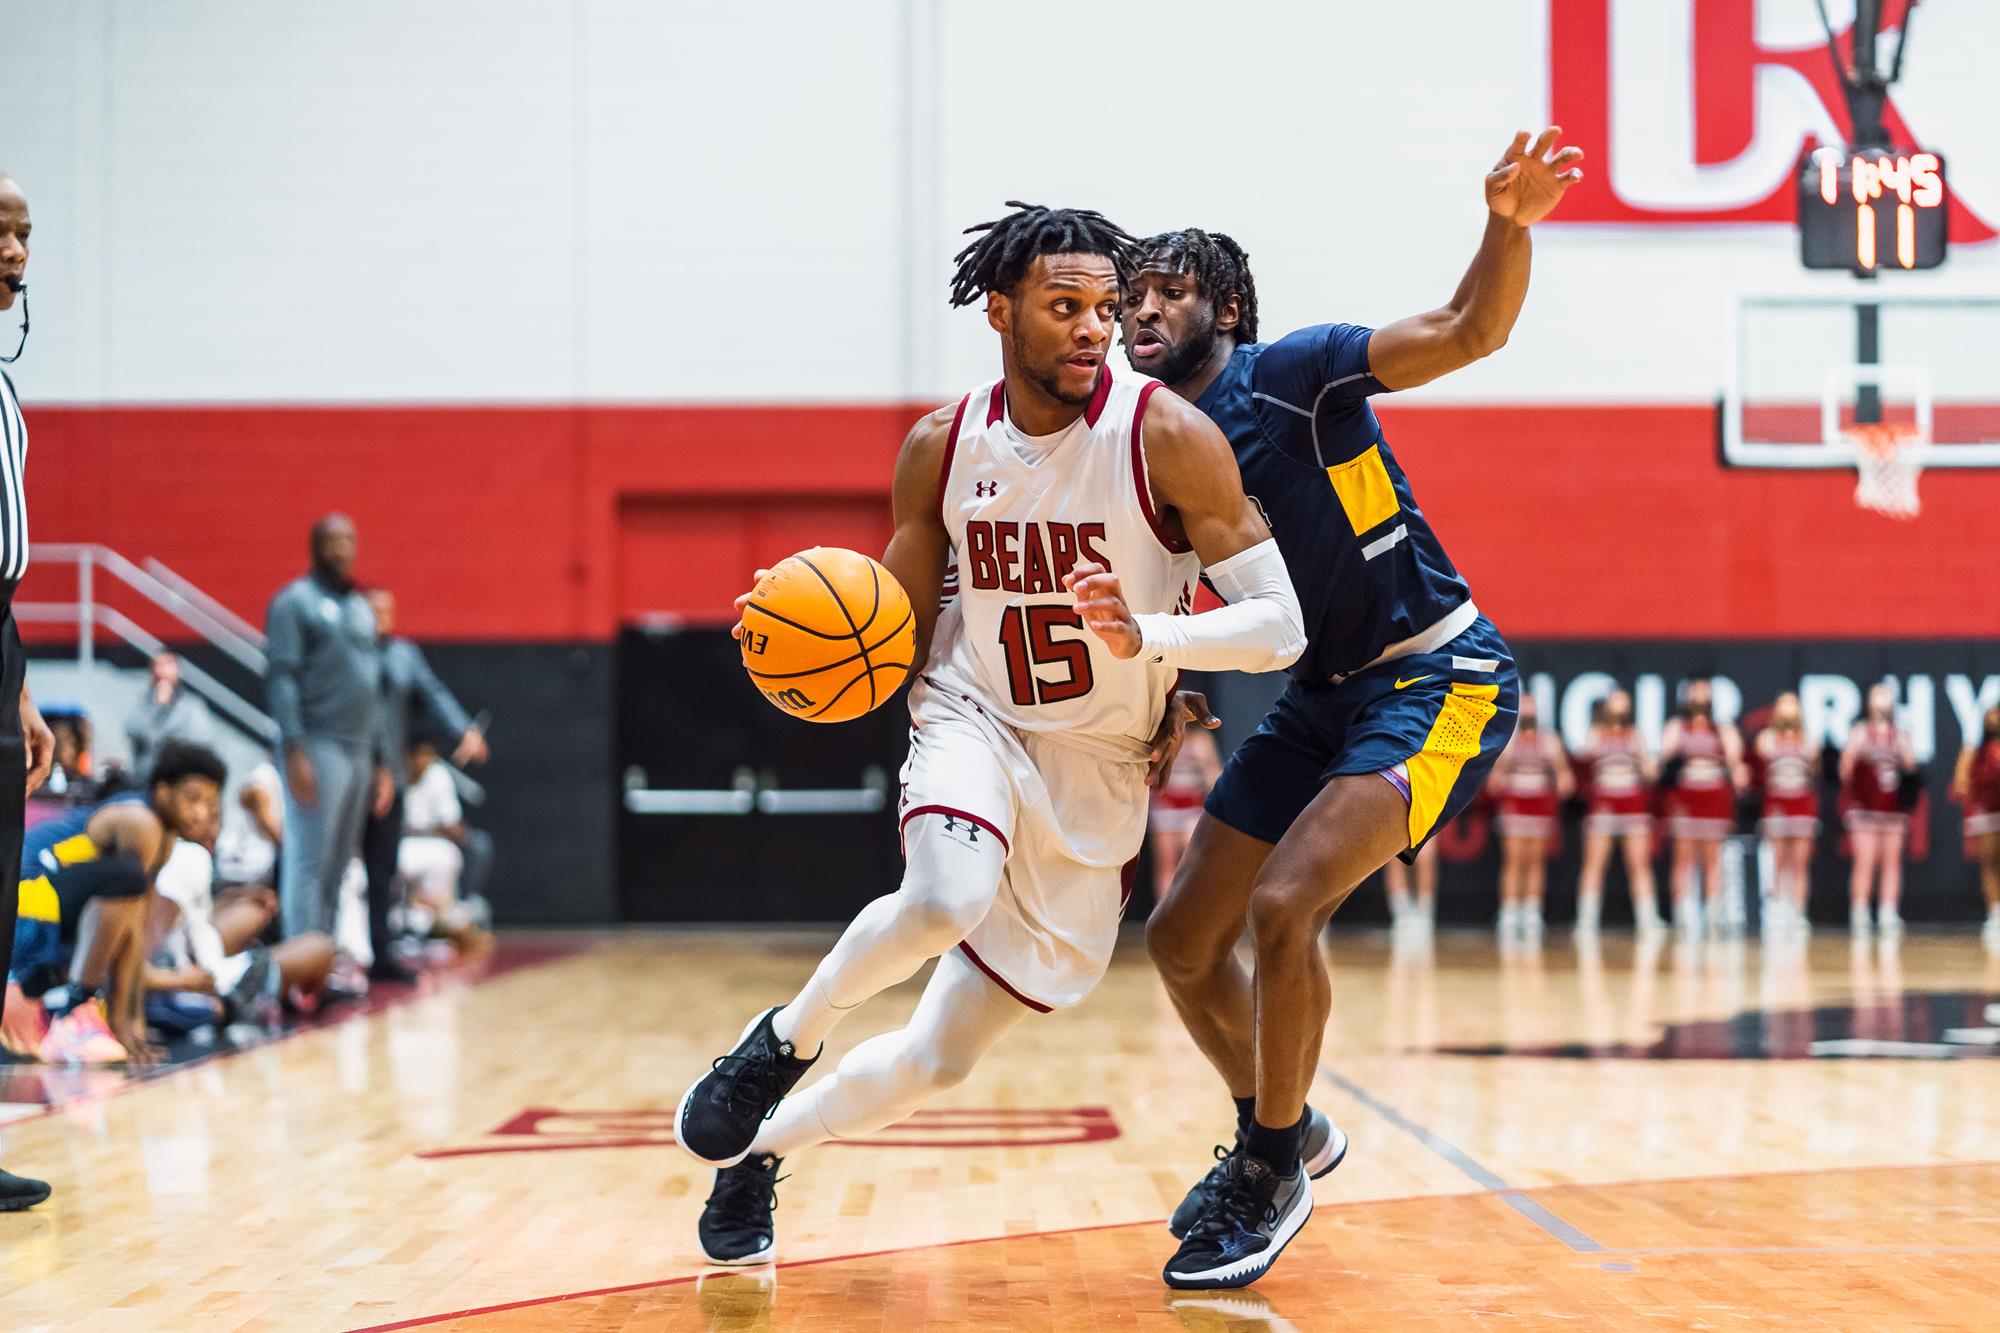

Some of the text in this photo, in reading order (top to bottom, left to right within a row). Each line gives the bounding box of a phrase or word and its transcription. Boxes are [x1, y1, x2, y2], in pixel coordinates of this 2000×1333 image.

[1857, 203, 1916, 269] 11
[967, 520, 1112, 594] BEARS
[999, 604, 1094, 706] 15
